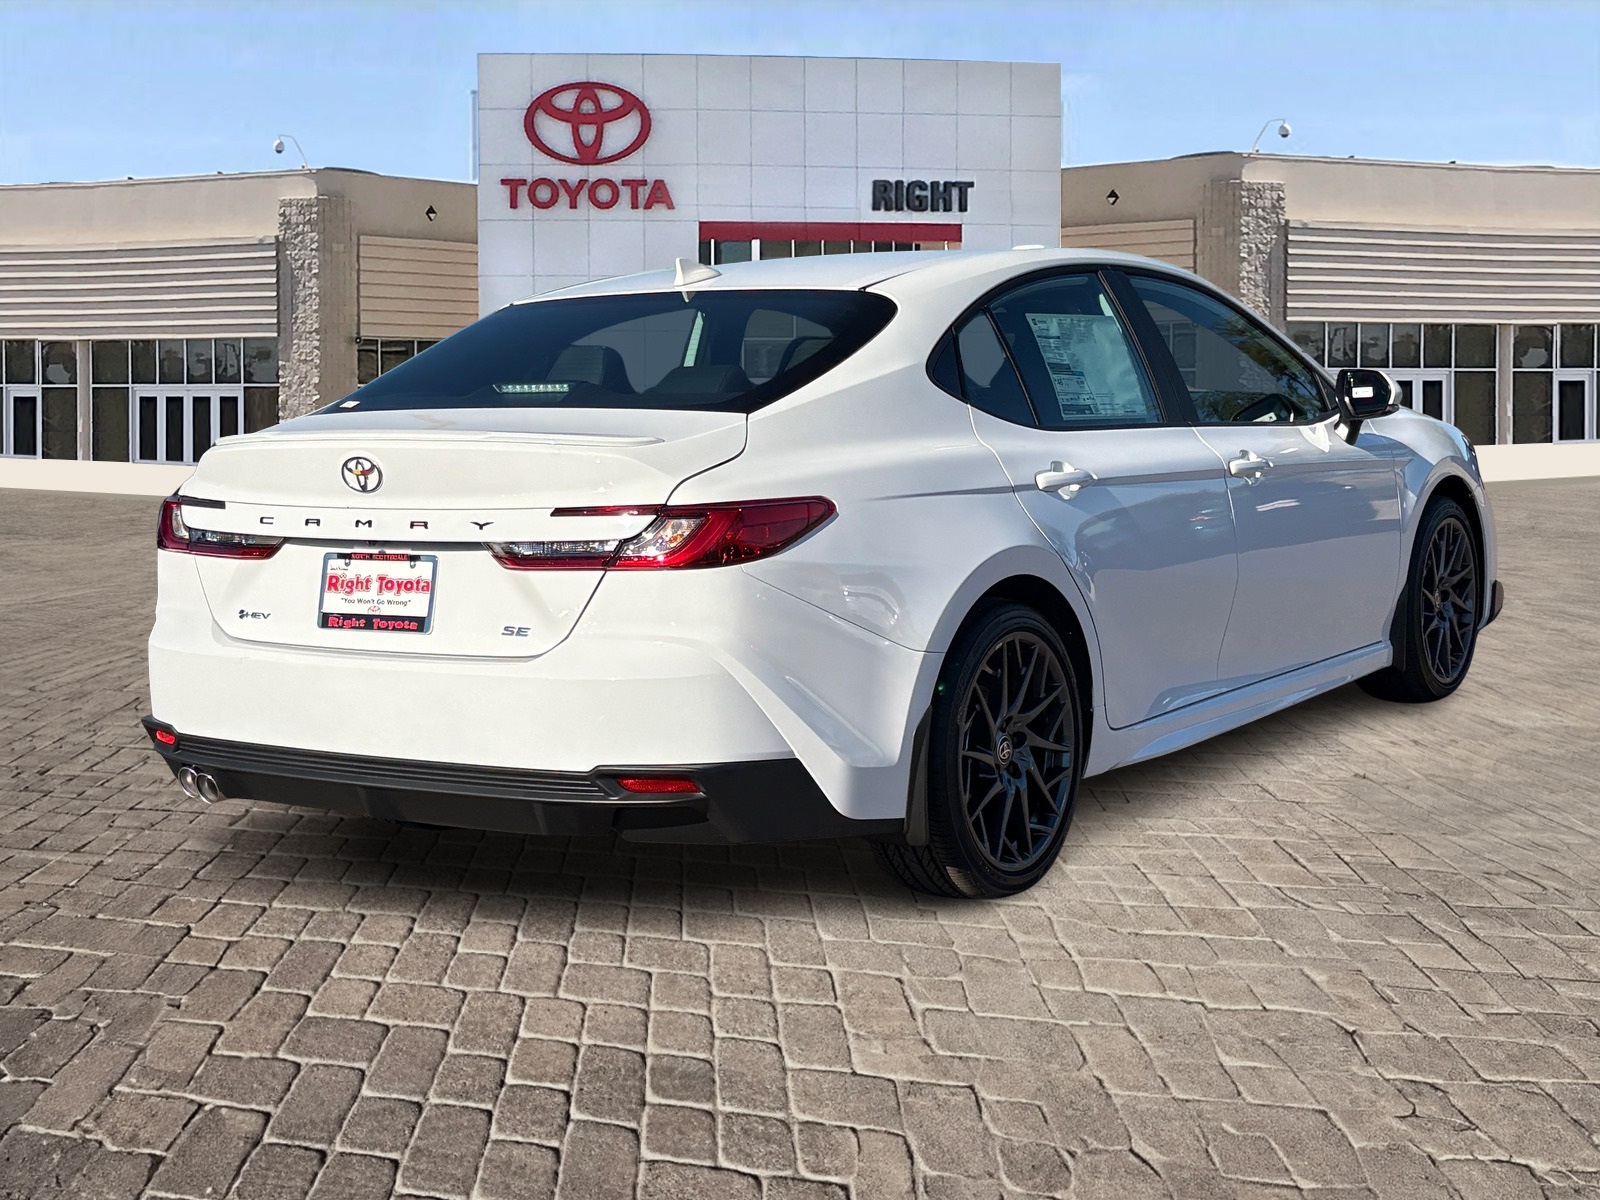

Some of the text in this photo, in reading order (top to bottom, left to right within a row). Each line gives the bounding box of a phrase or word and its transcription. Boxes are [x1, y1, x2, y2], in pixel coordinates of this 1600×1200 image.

[500, 178, 675, 210] TOYOTA
[871, 179, 975, 212] RIGHT
[259, 516, 495, 531] CAMRY
[327, 573, 431, 595] Right Toyota
[327, 616, 418, 630] Right Toyota
[501, 625, 531, 637] SE
